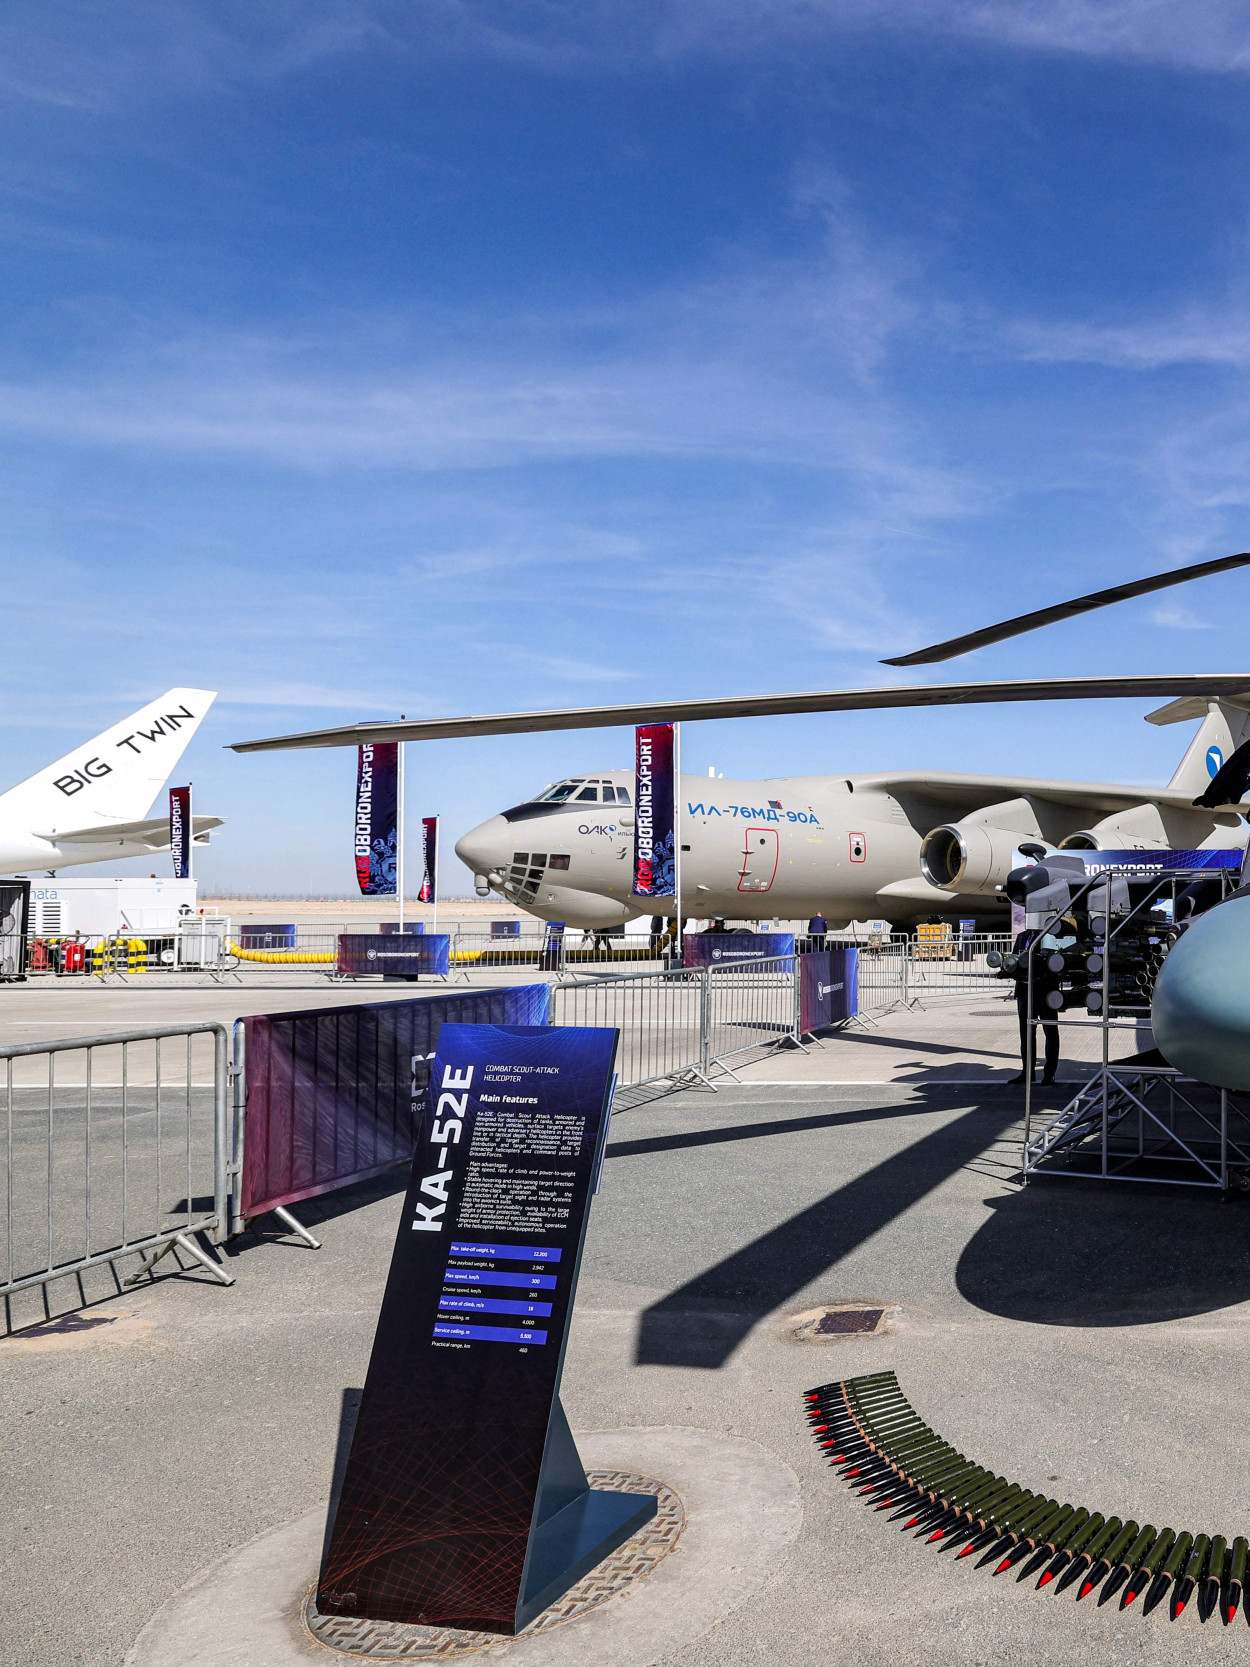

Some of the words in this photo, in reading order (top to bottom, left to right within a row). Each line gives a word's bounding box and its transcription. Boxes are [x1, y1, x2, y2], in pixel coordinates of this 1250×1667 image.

[52, 757, 112, 796] BIG
[116, 705, 196, 754] TWIN
[636, 737, 652, 890] ROSOBORONEXPORT
[412, 1065, 474, 1232] KA-52E
[480, 1094, 500, 1102] Main
